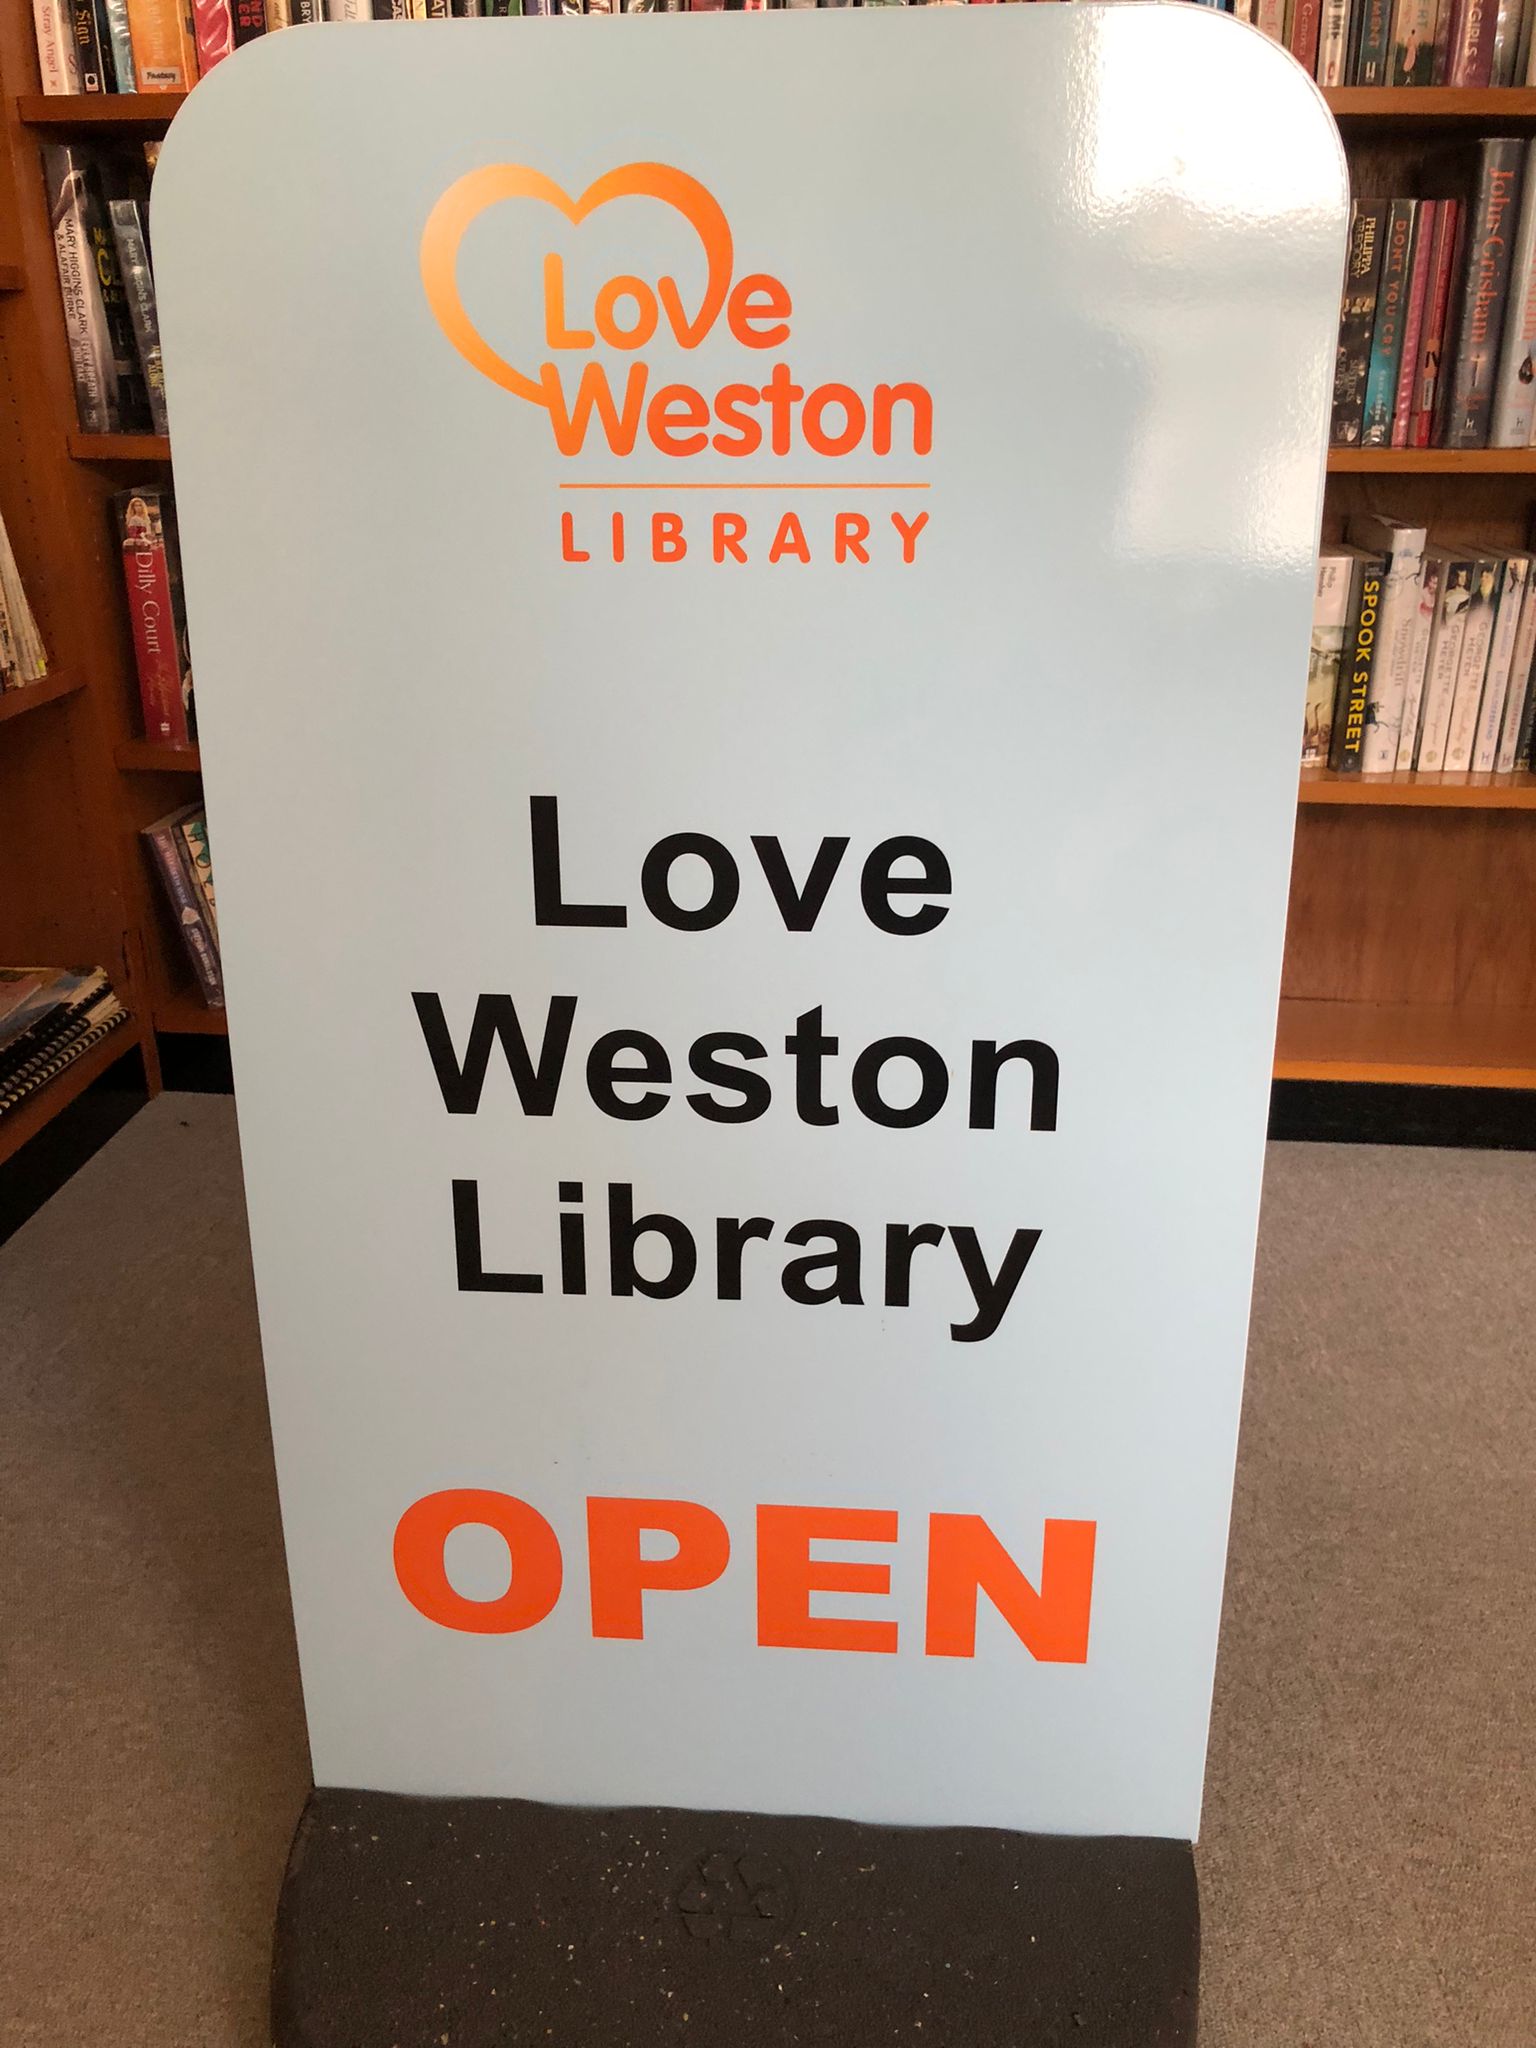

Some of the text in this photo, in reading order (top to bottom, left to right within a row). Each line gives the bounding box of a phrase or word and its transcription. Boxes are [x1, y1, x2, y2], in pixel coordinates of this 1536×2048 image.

[45, 39, 59, 73] Angel
[74, 9, 92, 45] Sign
[1464, 8, 1482, 57] GIRLS
[56, 233, 77, 320] & ALAFAIR BURKE
[64, 218, 89, 335] MARY HIGGINS CLARK
[127, 238, 139, 264] MARY
[139, 302, 152, 333] CLARK
[1350, 213, 1365, 279] GREGORY
[1359, 216, 1377, 276] PHILIPPA
[1470, 168, 1515, 344] John Grisham
[543, 252, 793, 351] Love
[1385, 280, 1399, 316] YOU
[1380, 323, 1394, 356] CRY
[540, 362, 933, 458] Weston
[561, 511, 929, 564] LIBRARY
[134, 551, 161, 655] Dilly Court
[1355, 580, 1380, 662] SPOOK
[1437, 640, 1449, 680] HEYER
[1443, 624, 1459, 695] GEORGETTE
[1463, 637, 1475, 677] HEYER
[1470, 621, 1488, 692] GEORGETTE
[1344, 672, 1369, 753] STREET
[530, 796, 952, 936] Love
[411, 992, 1060, 1132] Weston
[452, 1180, 1043, 1343] Library
[393, 1488, 1097, 1665] OPEN
